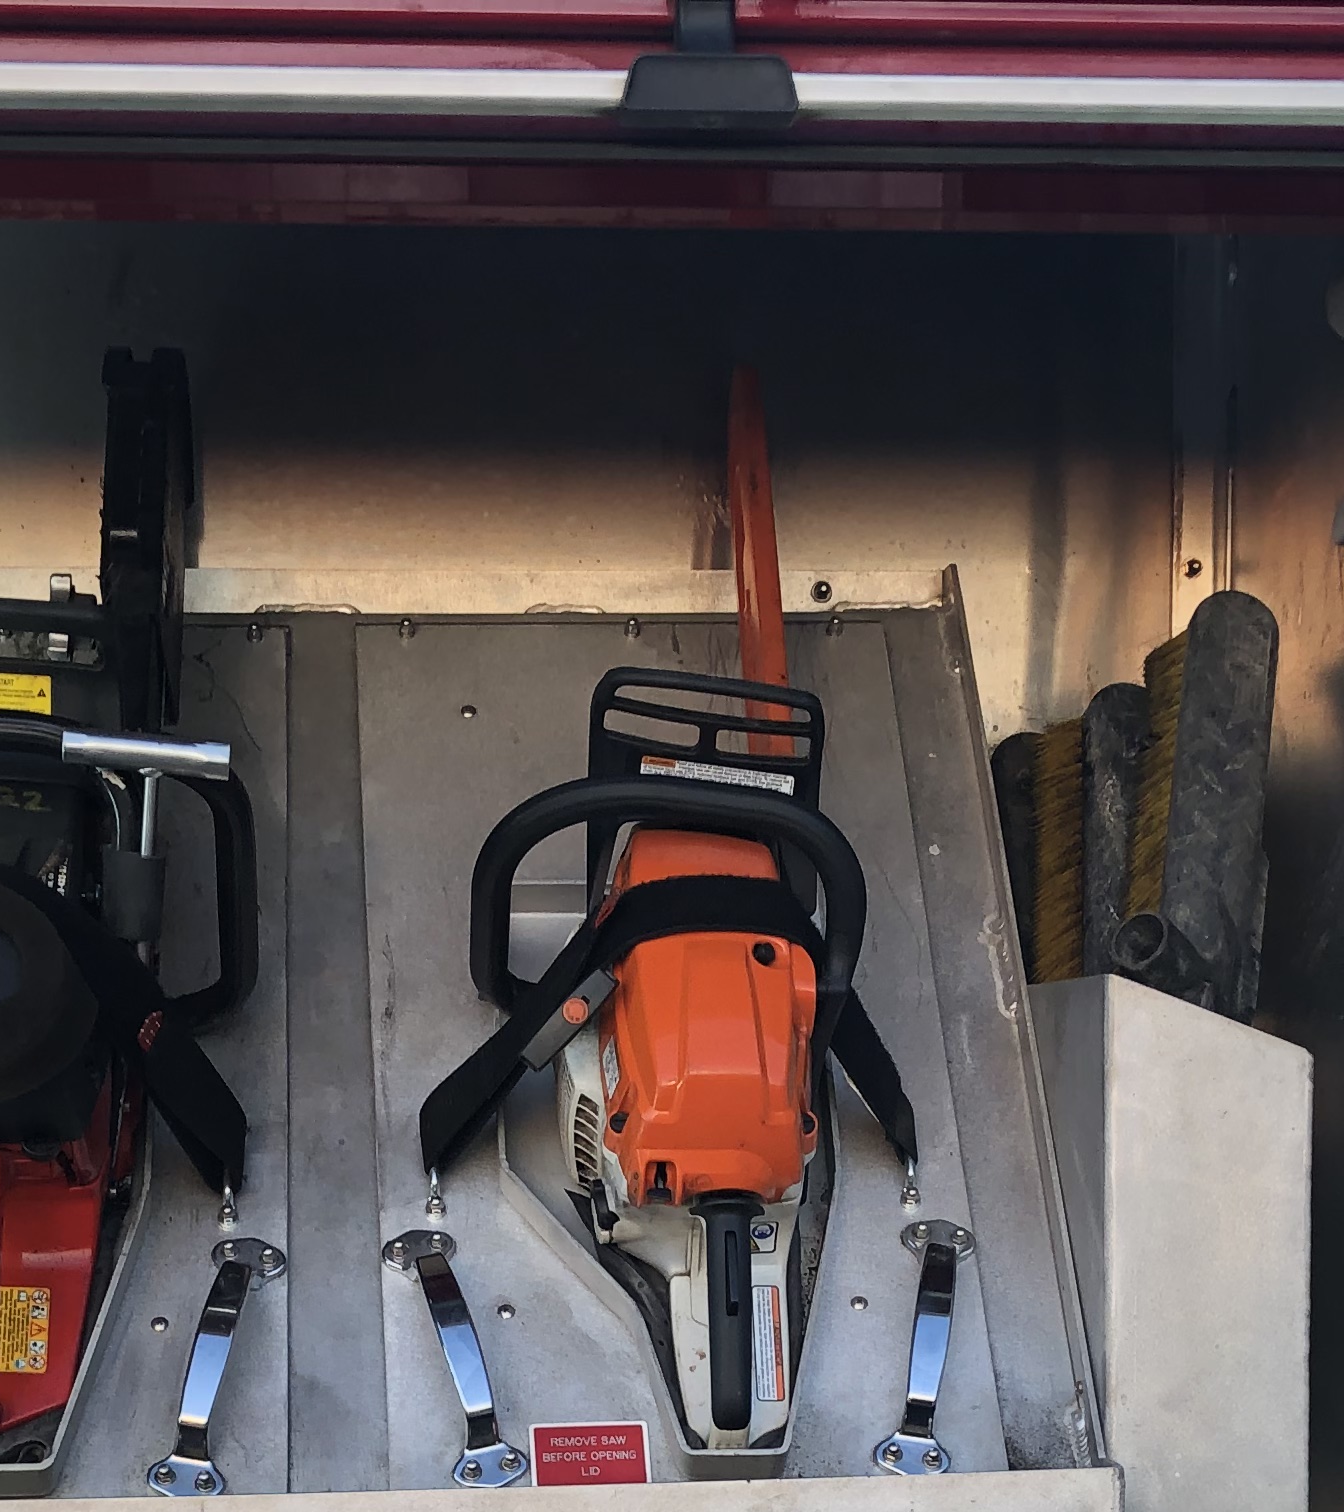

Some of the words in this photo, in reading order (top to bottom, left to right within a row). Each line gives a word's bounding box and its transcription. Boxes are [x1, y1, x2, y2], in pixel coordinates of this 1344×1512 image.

[550, 1436, 597, 1447] REMOVE
[601, 1435, 626, 1446] SAW
[542, 1451, 587, 1463] BEFORE
[590, 1450, 636, 1461] OPENING
[581, 1466, 601, 1477] LID
